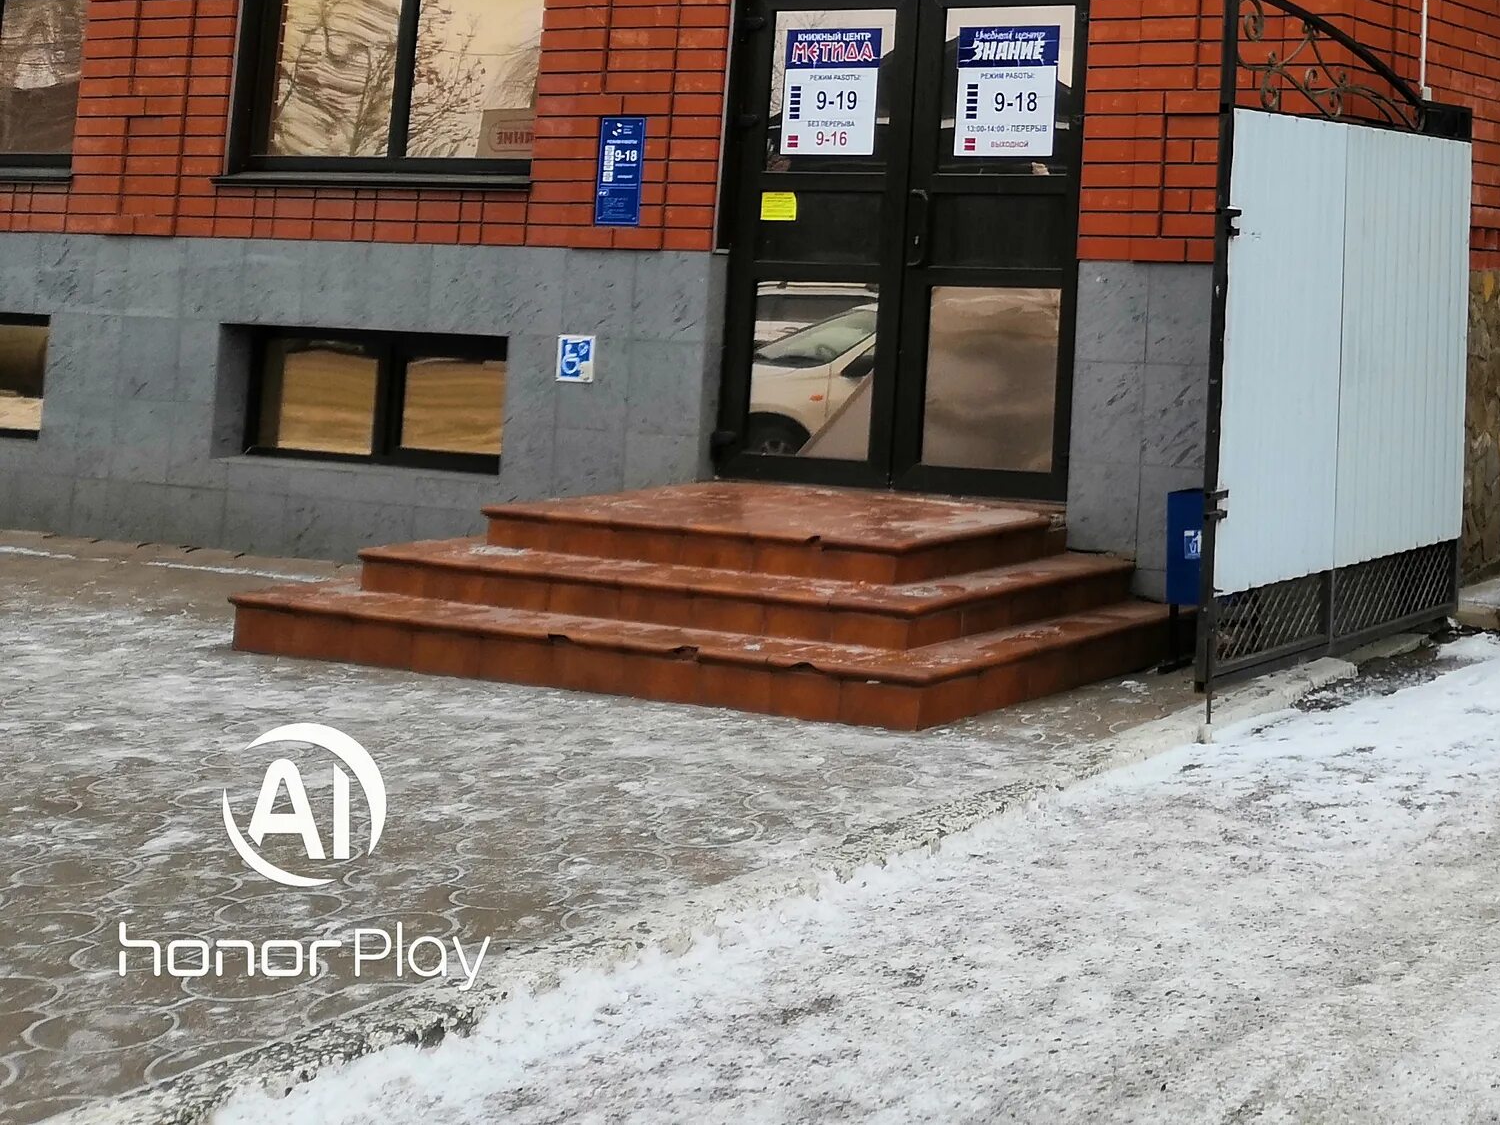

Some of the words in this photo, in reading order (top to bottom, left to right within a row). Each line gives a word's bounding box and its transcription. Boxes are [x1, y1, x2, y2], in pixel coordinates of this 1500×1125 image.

[797, 31, 841, 42] КНИЖНЫЙ
[842, 32, 872, 42] ЦЕНТР
[791, 41, 875, 63] МЕТИДА
[971, 39, 1046, 62] ЗНАНИЕ
[816, 90, 858, 110] 9-19
[994, 91, 1038, 112] 9-18
[815, 131, 848, 146] 9-16
[614, 149, 637, 162] 9-18
